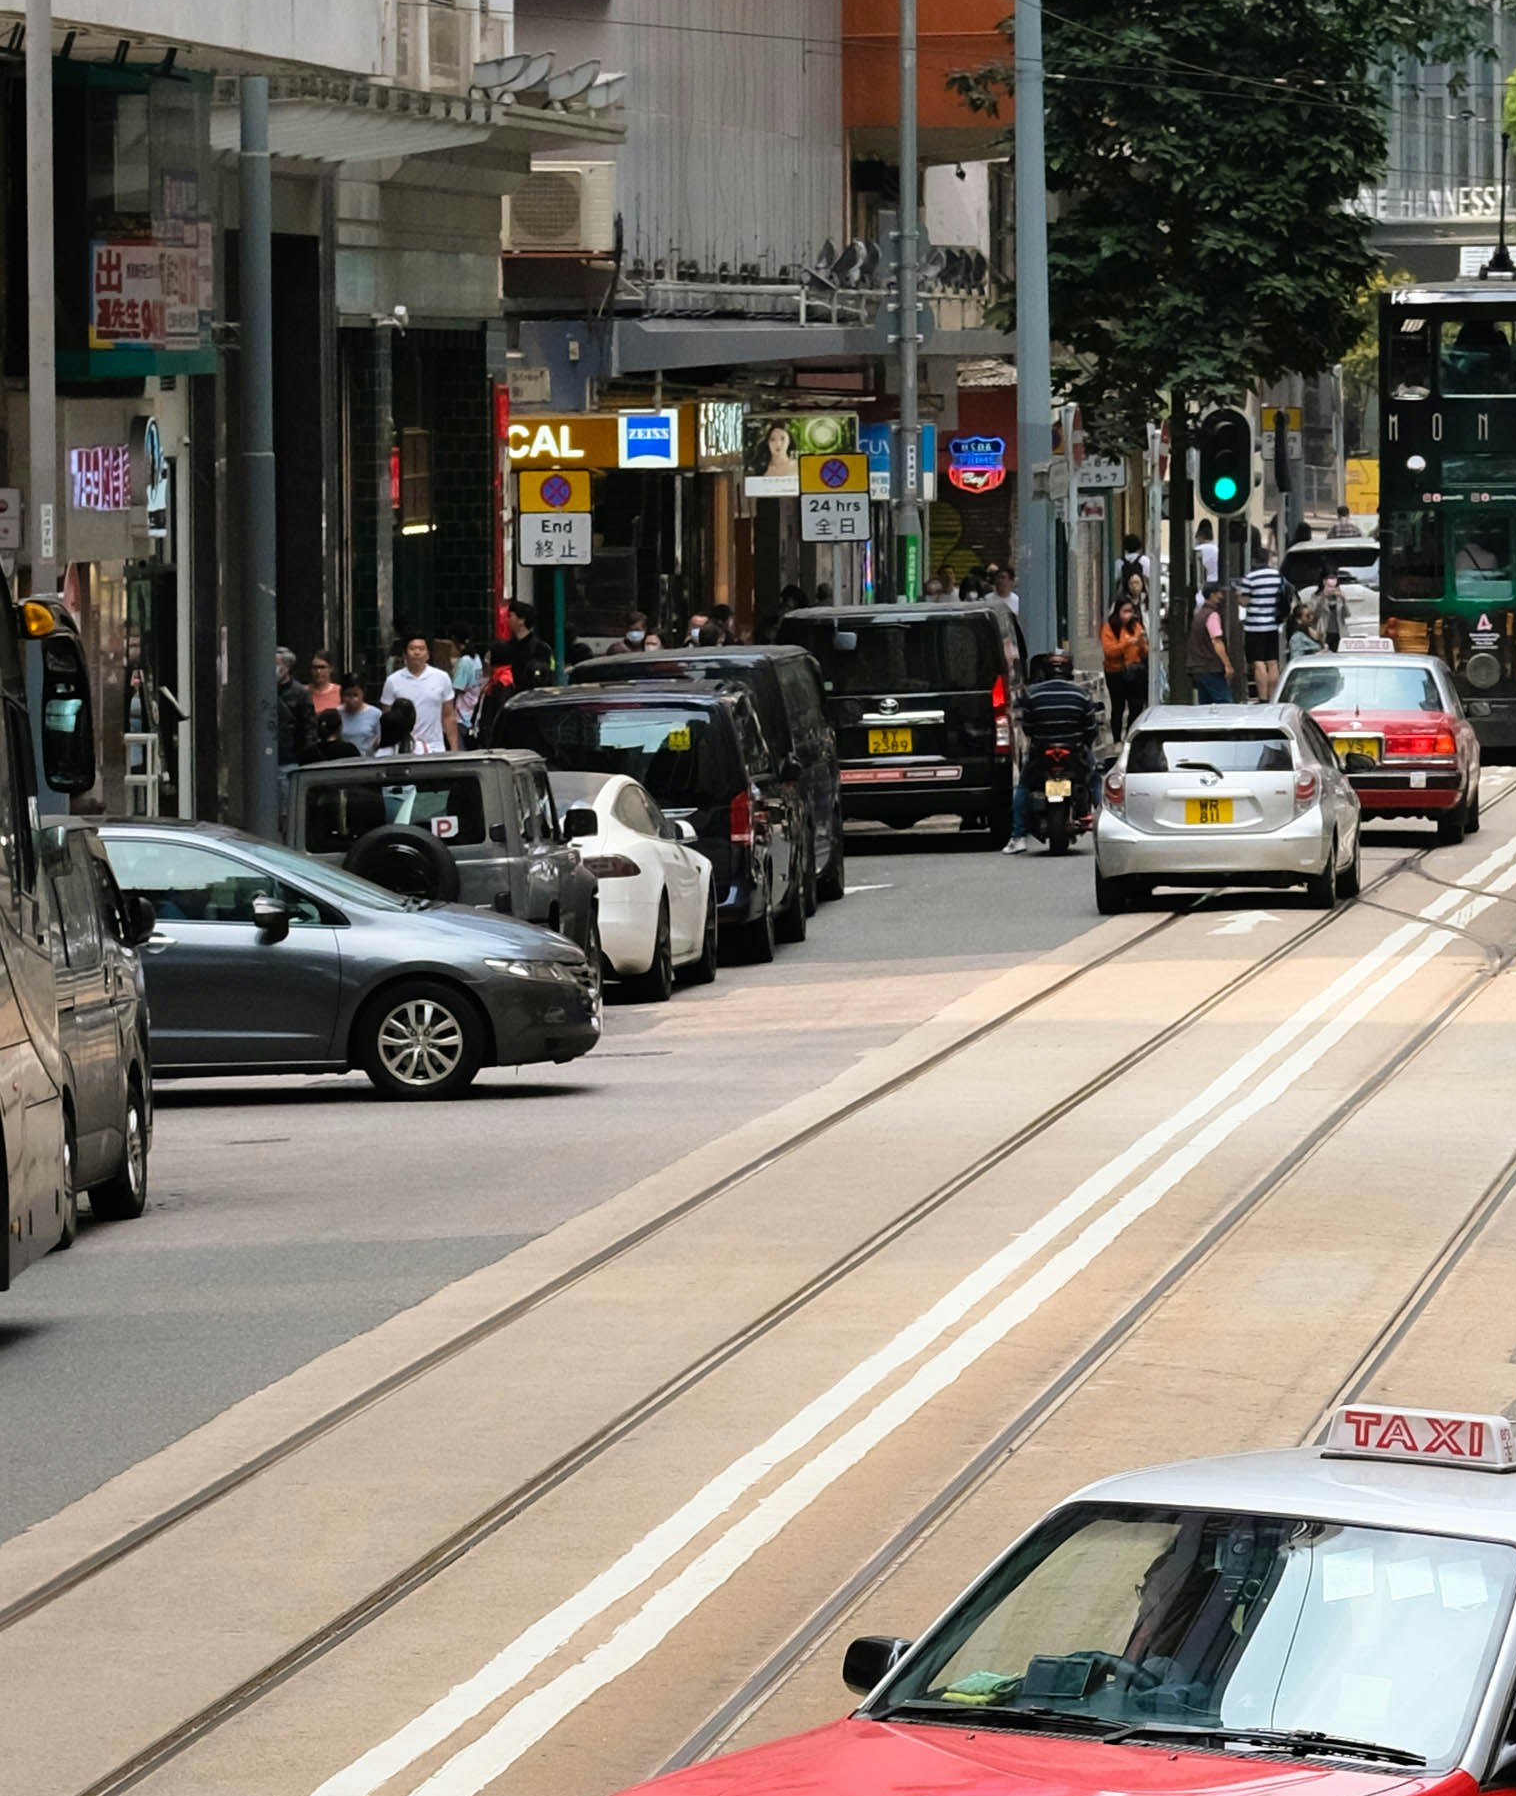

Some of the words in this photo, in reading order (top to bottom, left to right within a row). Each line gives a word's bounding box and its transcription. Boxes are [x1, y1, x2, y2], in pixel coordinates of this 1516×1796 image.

[1401, 186, 1510, 217] HENNESSY
[628, 428, 670, 440] ZEISS
[809, 500, 831, 512] 24
[836, 499, 861, 512] hrs
[541, 519, 573, 534] End
[816, 518, 856, 535] 全日
[535, 539, 578, 558] 終止
[1199, 798, 1219, 809] WR
[1200, 810, 1219, 823] 811
[437, 820, 452, 836] P
[1345, 1410, 1484, 1457] TAXI
